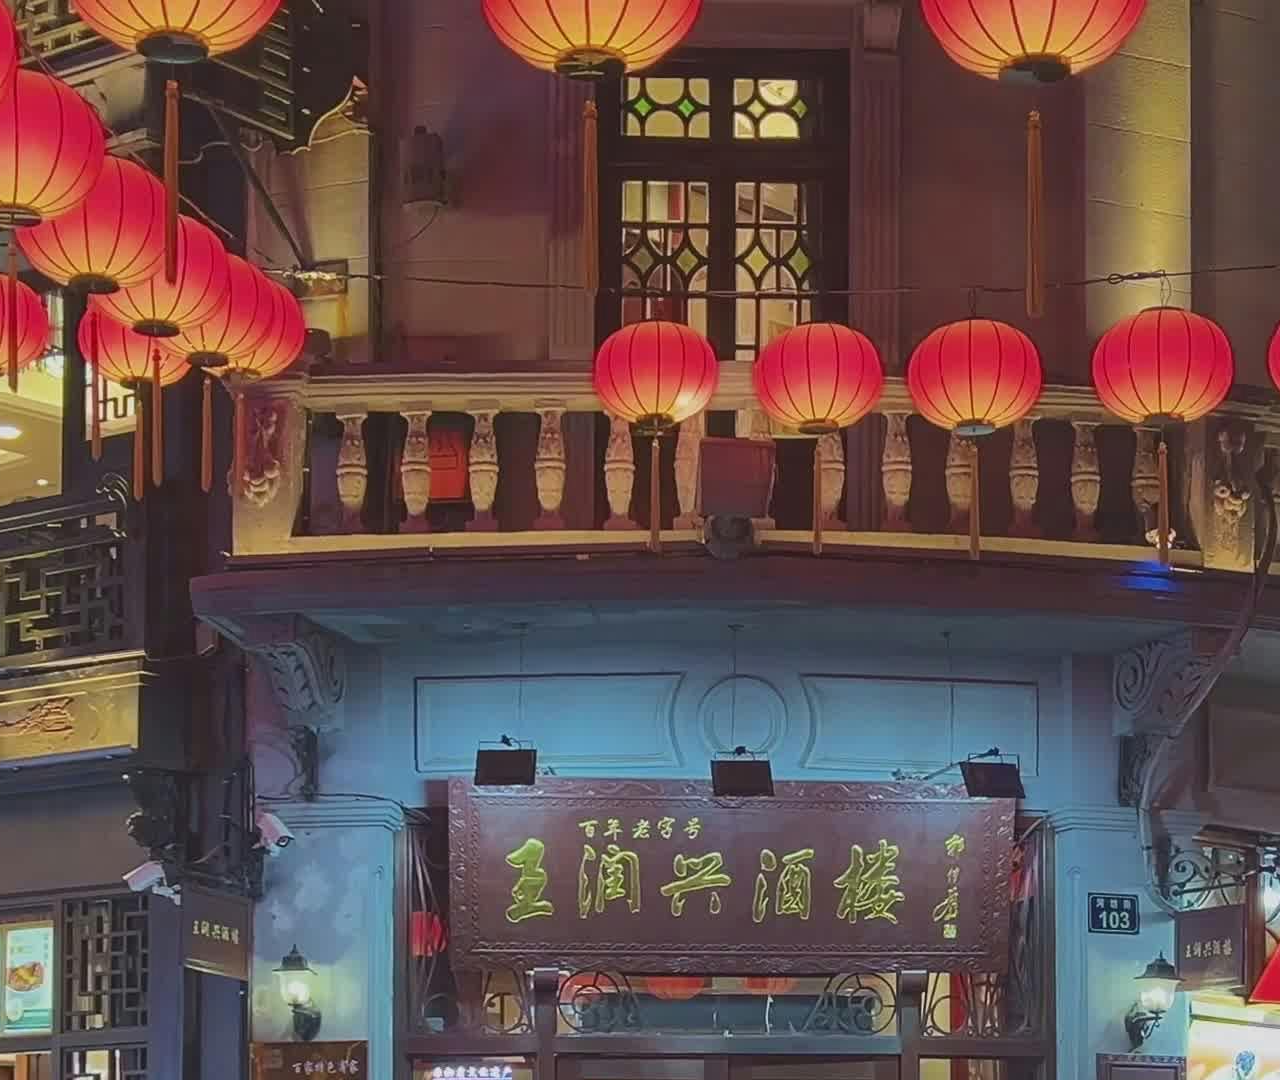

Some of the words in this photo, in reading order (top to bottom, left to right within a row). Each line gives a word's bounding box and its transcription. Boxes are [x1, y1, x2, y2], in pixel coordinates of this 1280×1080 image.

[577, 817, 703, 841] 百年老字号
[504, 838, 906, 925] 王润兴酒楼
[1098, 911, 1131, 930] 103
